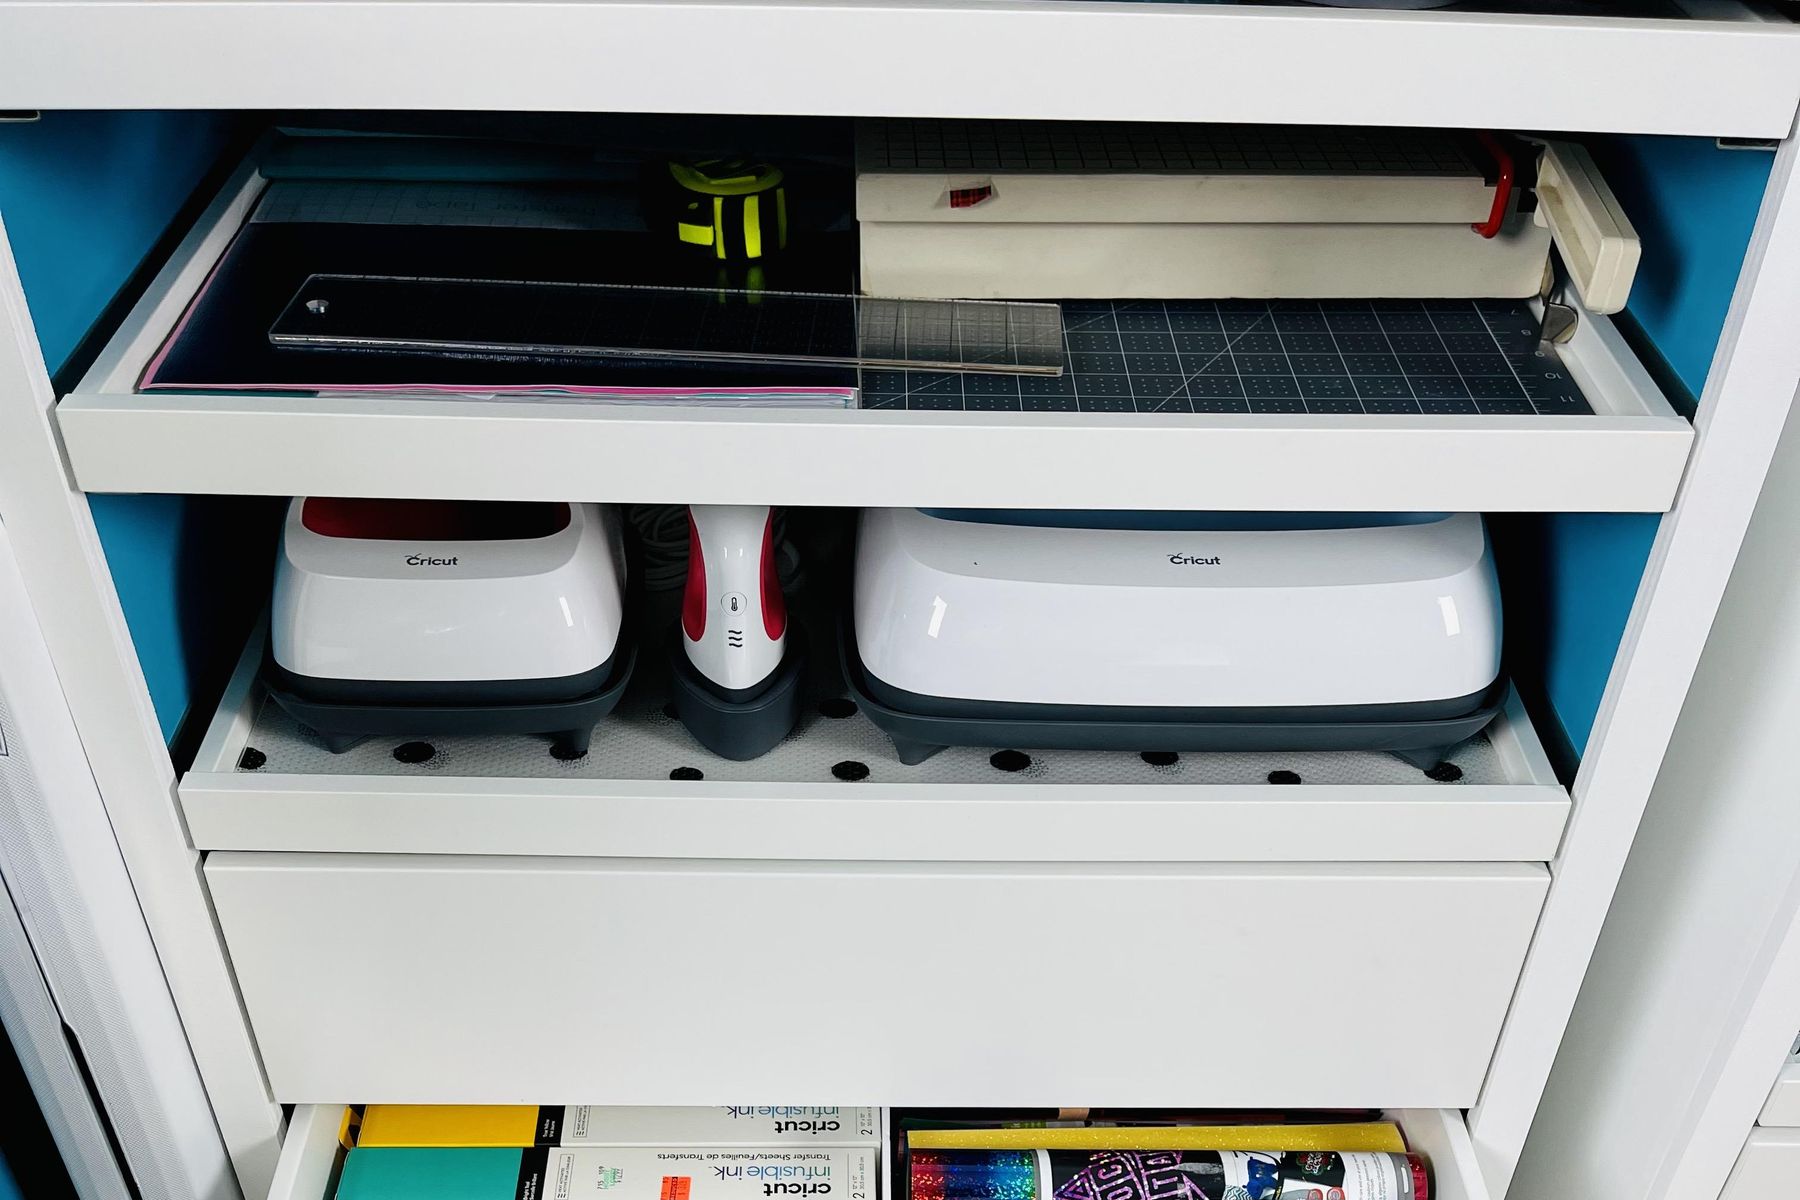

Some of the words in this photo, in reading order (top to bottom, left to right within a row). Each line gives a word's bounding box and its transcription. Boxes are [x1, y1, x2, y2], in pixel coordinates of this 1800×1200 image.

[404, 553, 458, 565] Cricut
[1167, 553, 1220, 565] Cricut
[774, 1120, 840, 1135] cricut
[747, 1166, 831, 1180] infusible
[764, 1183, 831, 1198] cricut
